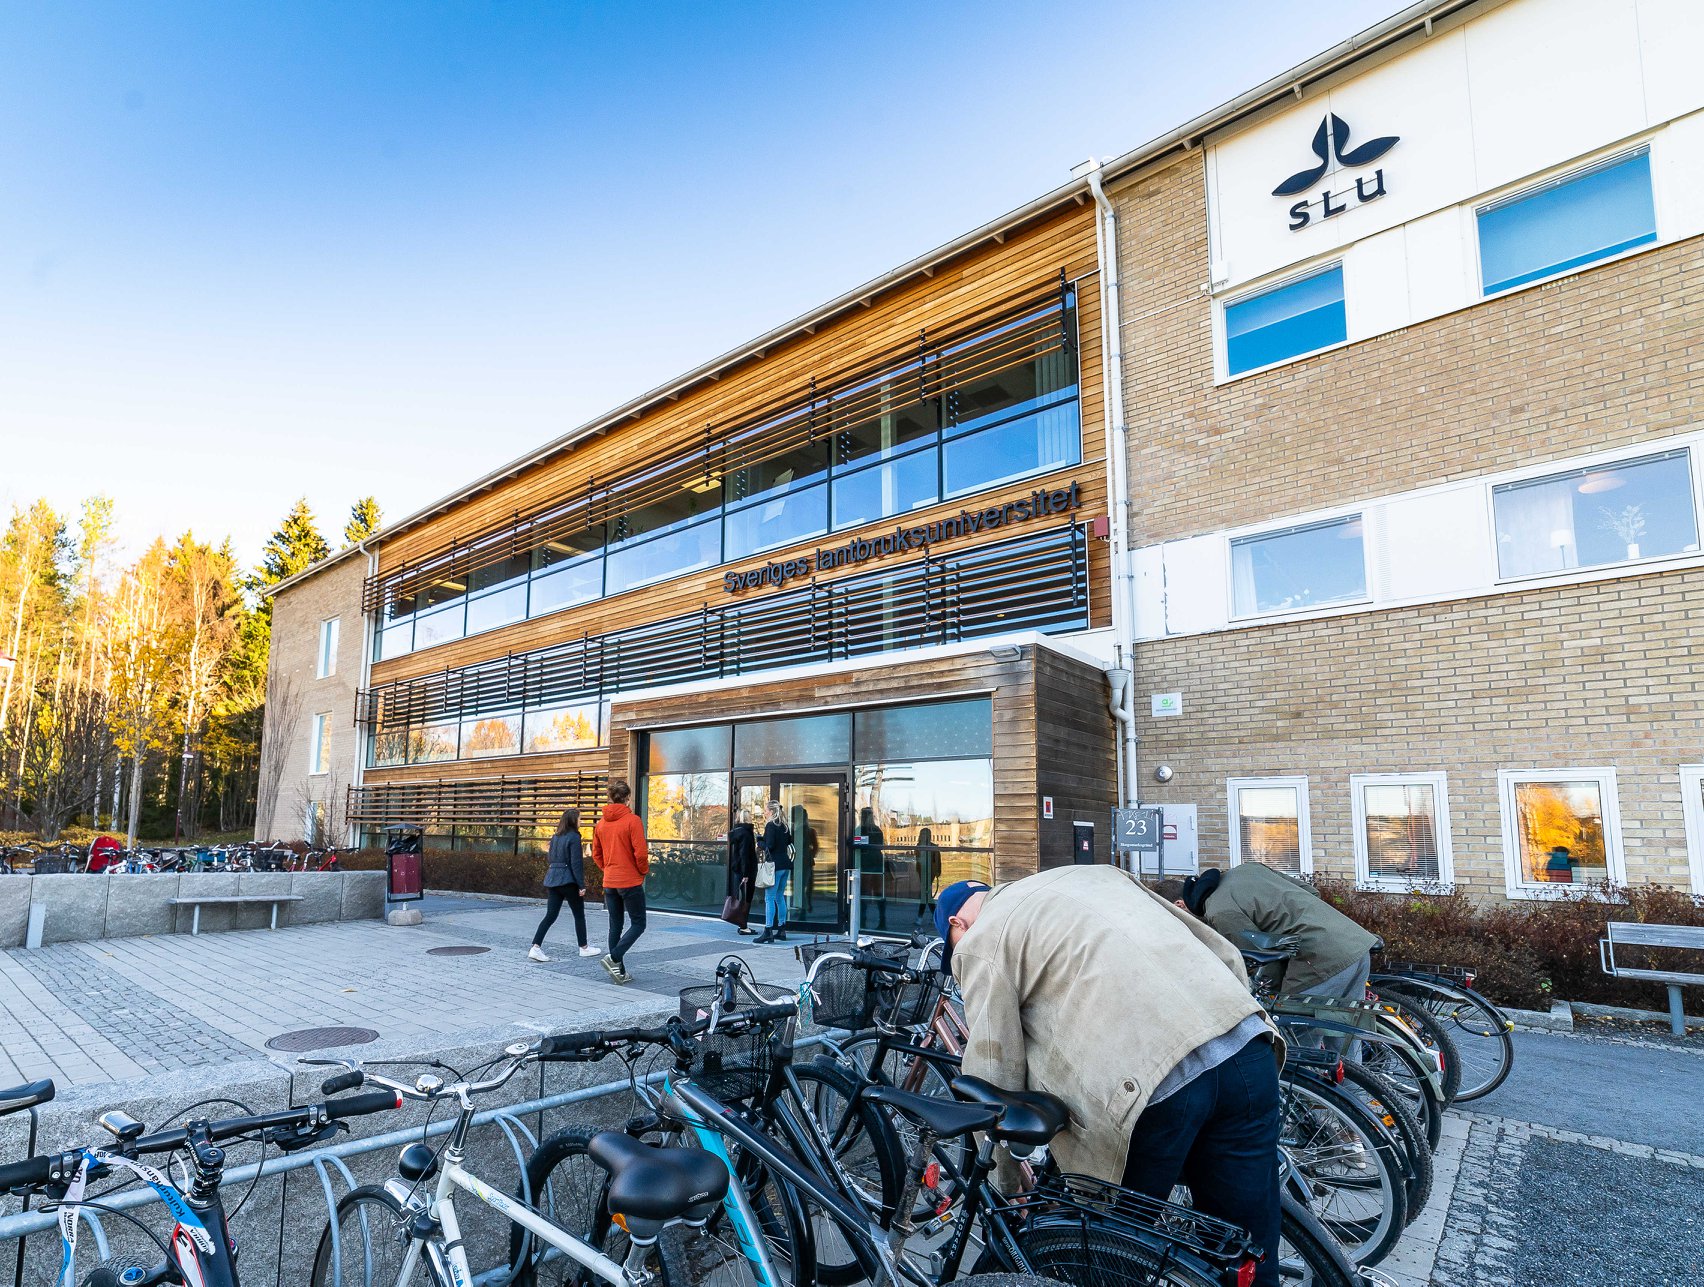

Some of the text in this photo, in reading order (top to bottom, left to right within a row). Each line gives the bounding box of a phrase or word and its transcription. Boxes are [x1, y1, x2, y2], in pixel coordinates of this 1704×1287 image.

[1289, 169, 1386, 231] SLU
[723, 480, 1081, 593] Sveriges lantbruksuniversitet
[1125, 819, 1147, 836] 23
